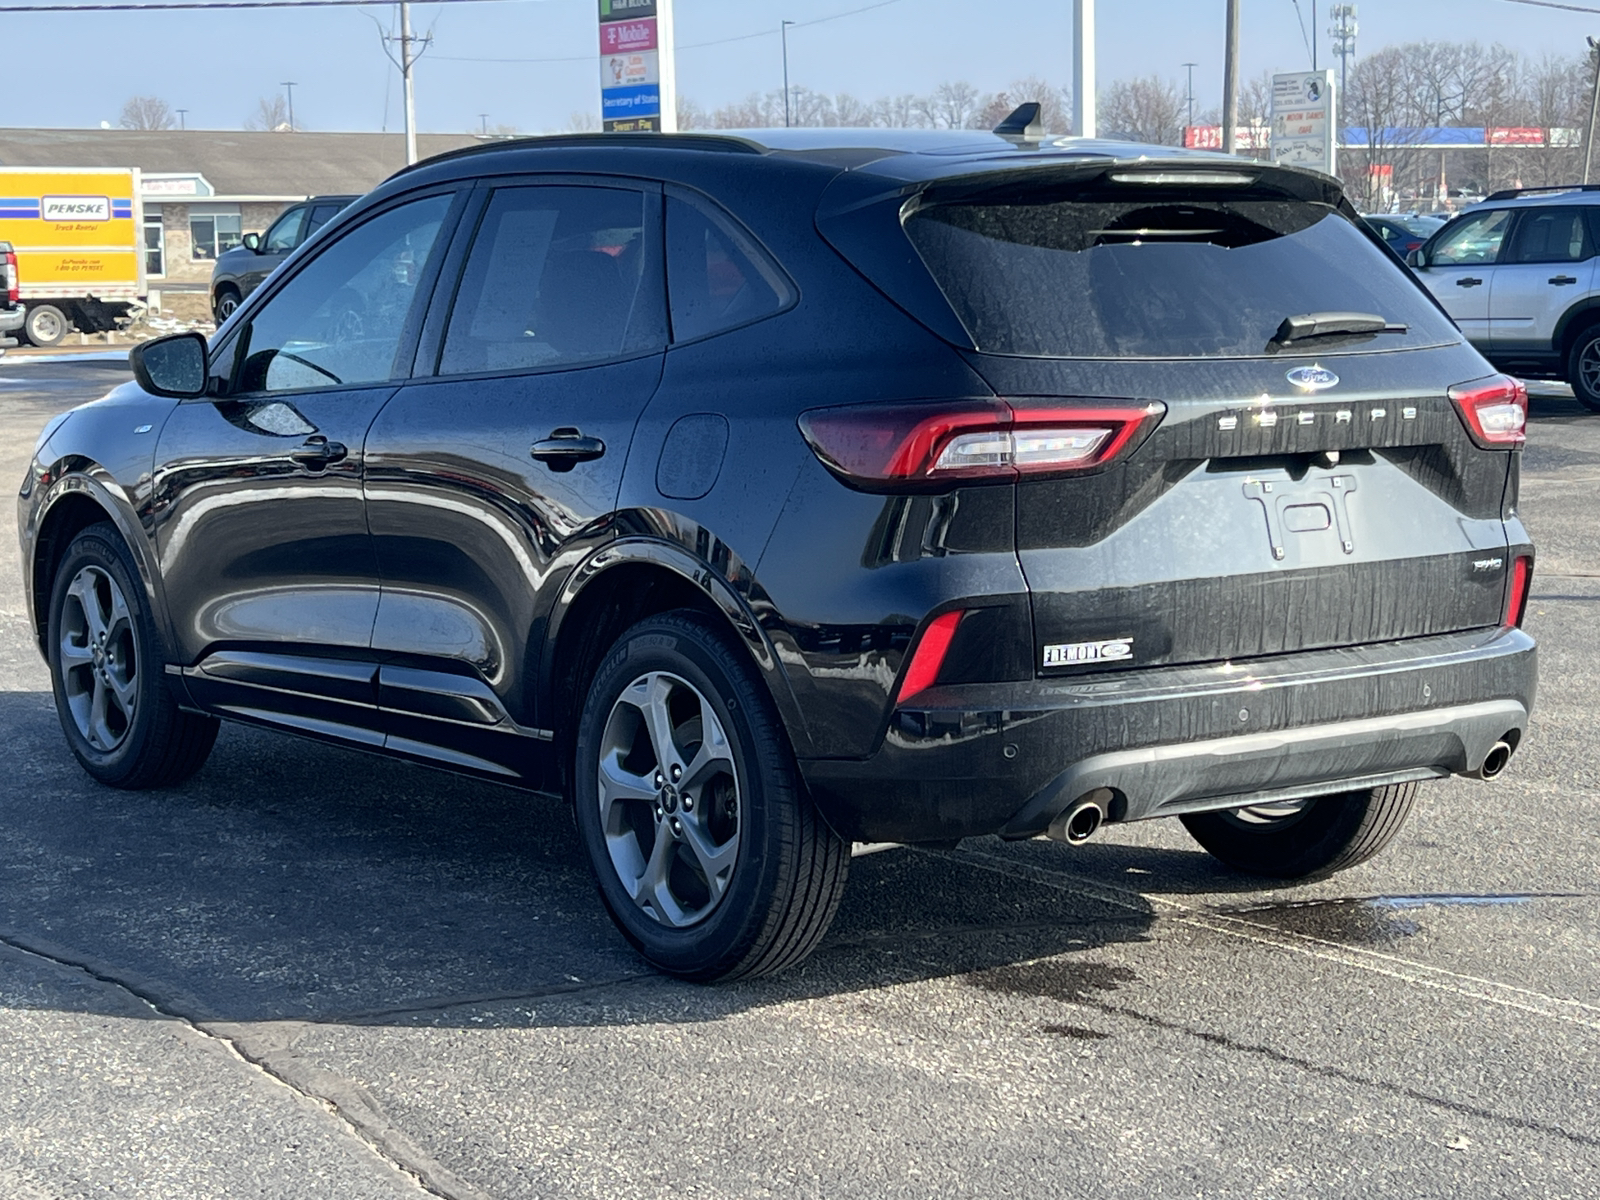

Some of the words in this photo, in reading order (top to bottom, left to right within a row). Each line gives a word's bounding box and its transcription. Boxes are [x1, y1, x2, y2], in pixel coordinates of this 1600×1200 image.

[617, 24, 650, 42] Mobile
[603, 97, 633, 108] Secretary
[634, 94, 641, 105] of
[641, 94, 658, 104] State
[47, 204, 105, 213] PENSKE
[1043, 645, 1102, 663] FREMONT
[588, 648, 627, 708] MICHELIN
